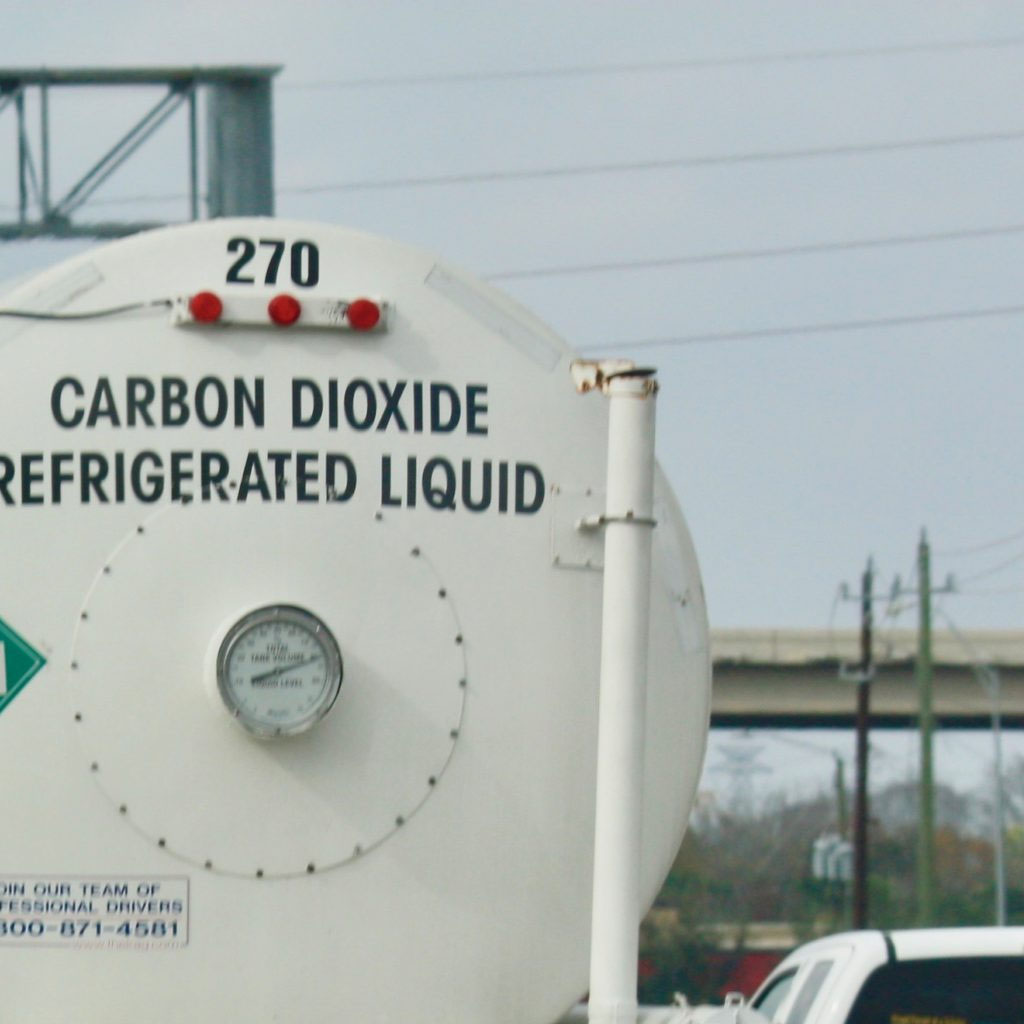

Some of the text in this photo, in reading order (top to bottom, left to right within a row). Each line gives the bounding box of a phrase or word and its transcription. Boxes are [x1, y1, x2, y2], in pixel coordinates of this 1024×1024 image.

[225, 237, 320, 288] 270
[50, 375, 489, 436] CARBON DIOXIDE
[378, 455, 546, 515] LIQUID
[33, 882, 71, 897] OUR
[81, 883, 128, 897] TEAM
[136, 883, 161, 897] OF
[106, 900, 183, 915] DRIVERS
